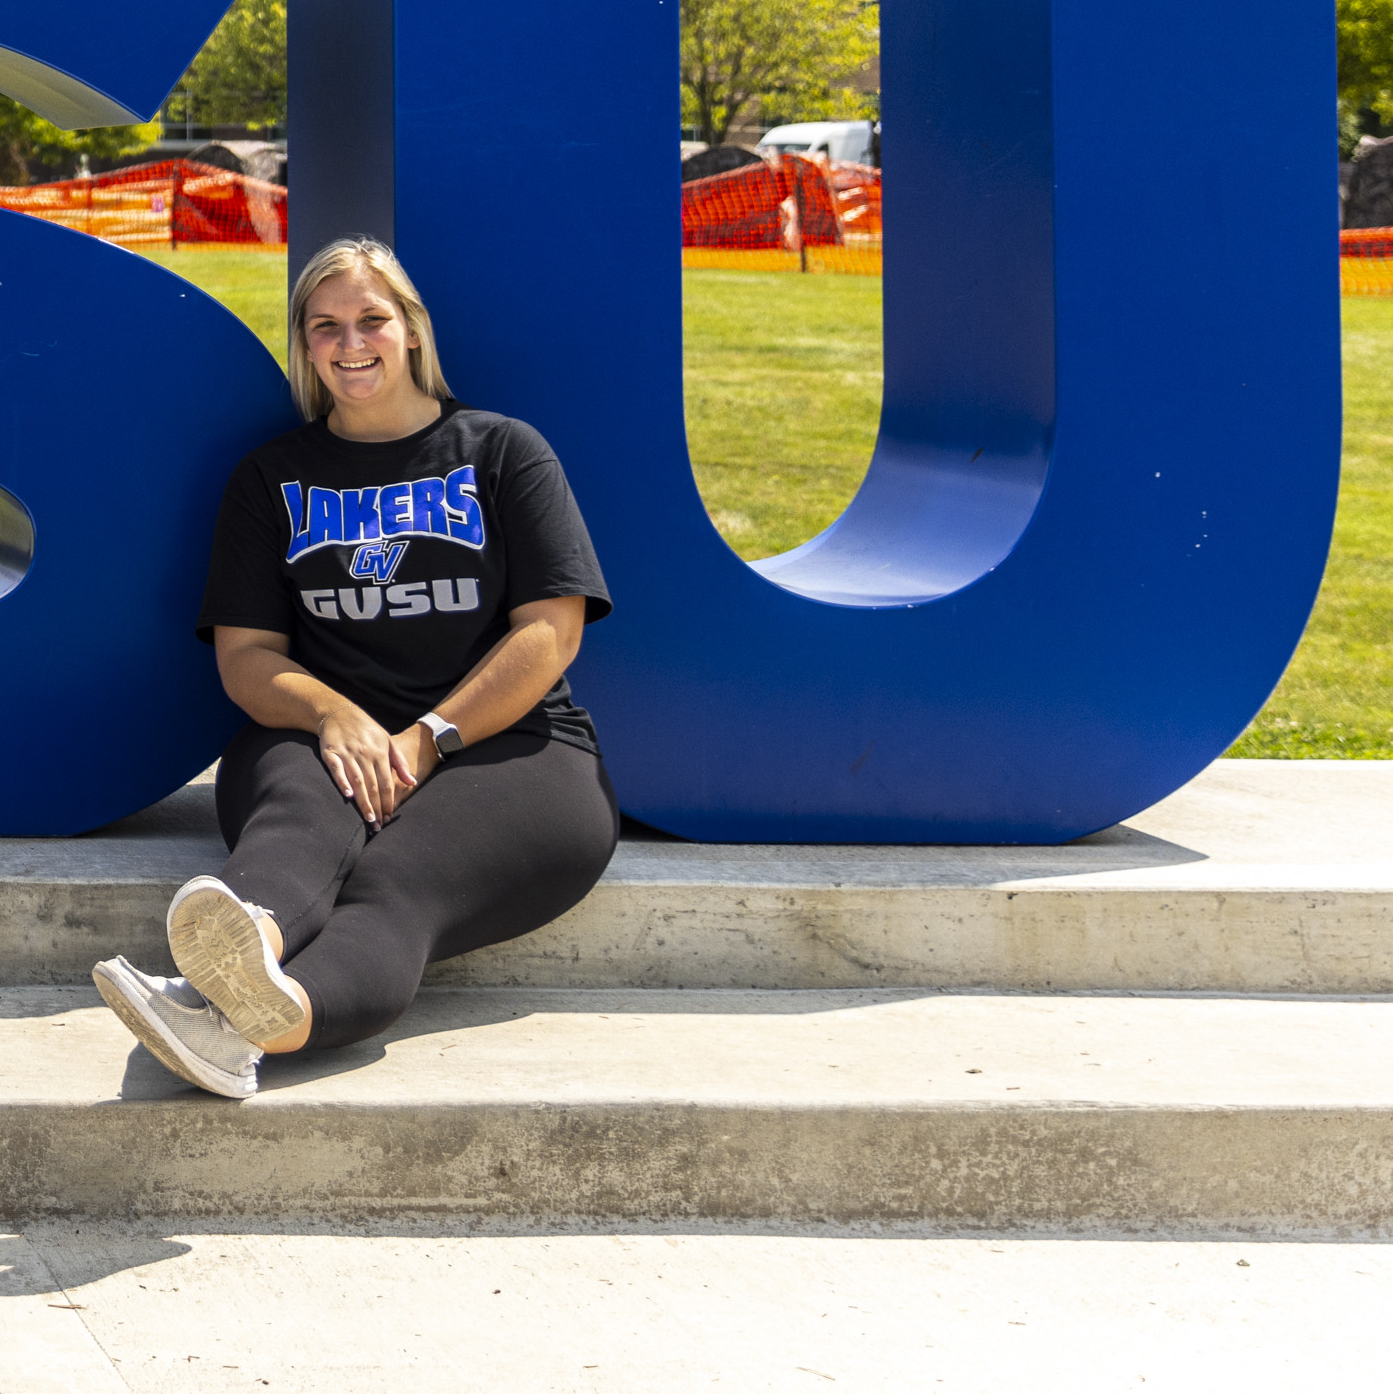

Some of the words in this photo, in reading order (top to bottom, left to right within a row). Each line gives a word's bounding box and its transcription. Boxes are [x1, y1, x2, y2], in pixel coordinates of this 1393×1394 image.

[280, 465, 486, 564] LAKERS
[349, 540, 411, 585] GV
[300, 578, 480, 620] GVSU
